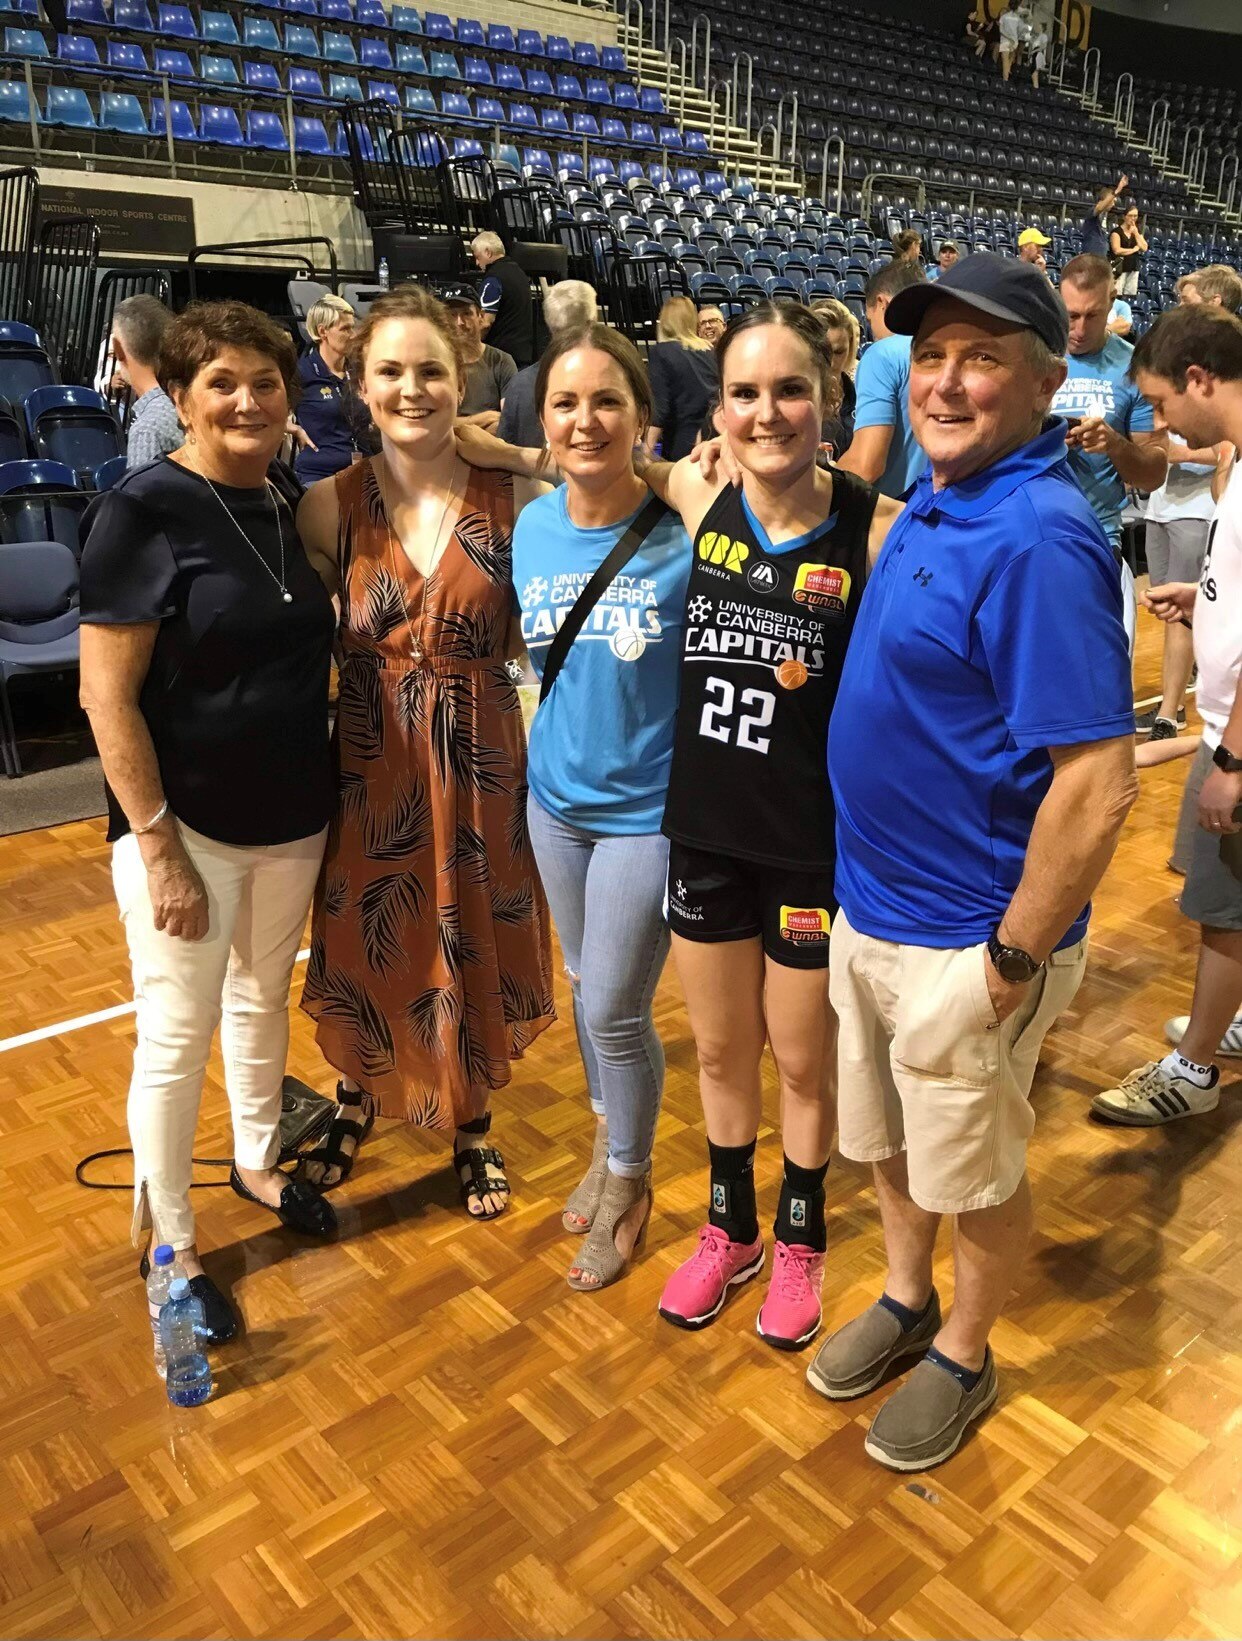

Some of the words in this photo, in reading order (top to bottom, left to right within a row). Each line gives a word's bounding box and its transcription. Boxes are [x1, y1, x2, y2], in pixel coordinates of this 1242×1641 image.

[41, 204, 84, 215] NATIONAL
[86, 208, 119, 218] INDOOR
[122, 210, 154, 220] SPORTS
[157, 213, 188, 223] CENTRE
[1057, 384, 1113, 395] ANBERRA
[1065, 378, 1101, 386] IVERSITY
[1051, 393, 1115, 409] PITALS
[552, 572, 635, 587] UNIVEITY
[640, 578, 657, 590] OF
[698, 563, 731, 582] CANBERRA
[807, 574, 842, 588] CHEMIST
[550, 586, 658, 606] CAERRA
[520, 604, 662, 640] CAPTALS
[718, 599, 805, 627] UNIVERSITY
[808, 620, 826, 632] OF
[716, 611, 825, 646] CANBERRA
[684, 627, 826, 670] CAPITALS
[698, 675, 777, 755] 22
[787, 915, 821, 925] CHEMIST
